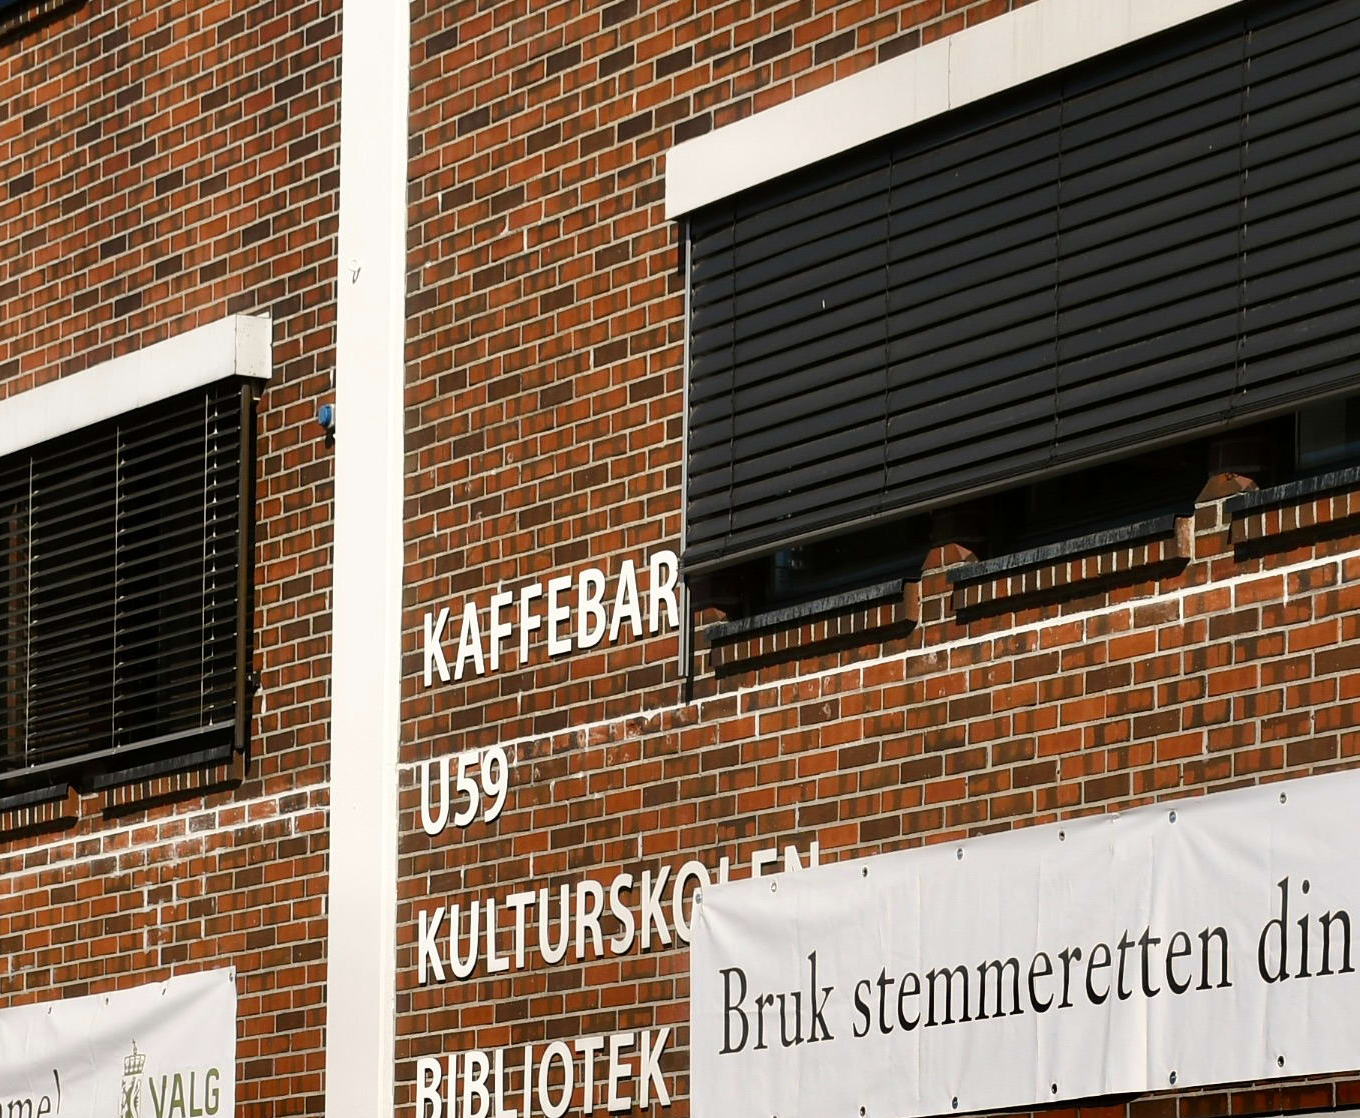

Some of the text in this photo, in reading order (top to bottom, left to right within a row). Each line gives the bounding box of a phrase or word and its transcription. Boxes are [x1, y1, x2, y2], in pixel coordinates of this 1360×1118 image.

[423, 549, 680, 687] KAFFEBAR
[418, 747, 510, 835] U59
[417, 841, 820, 984] KULTURSKO
[719, 950, 835, 1056] Bruk
[853, 926, 1233, 1038] stemmeretten
